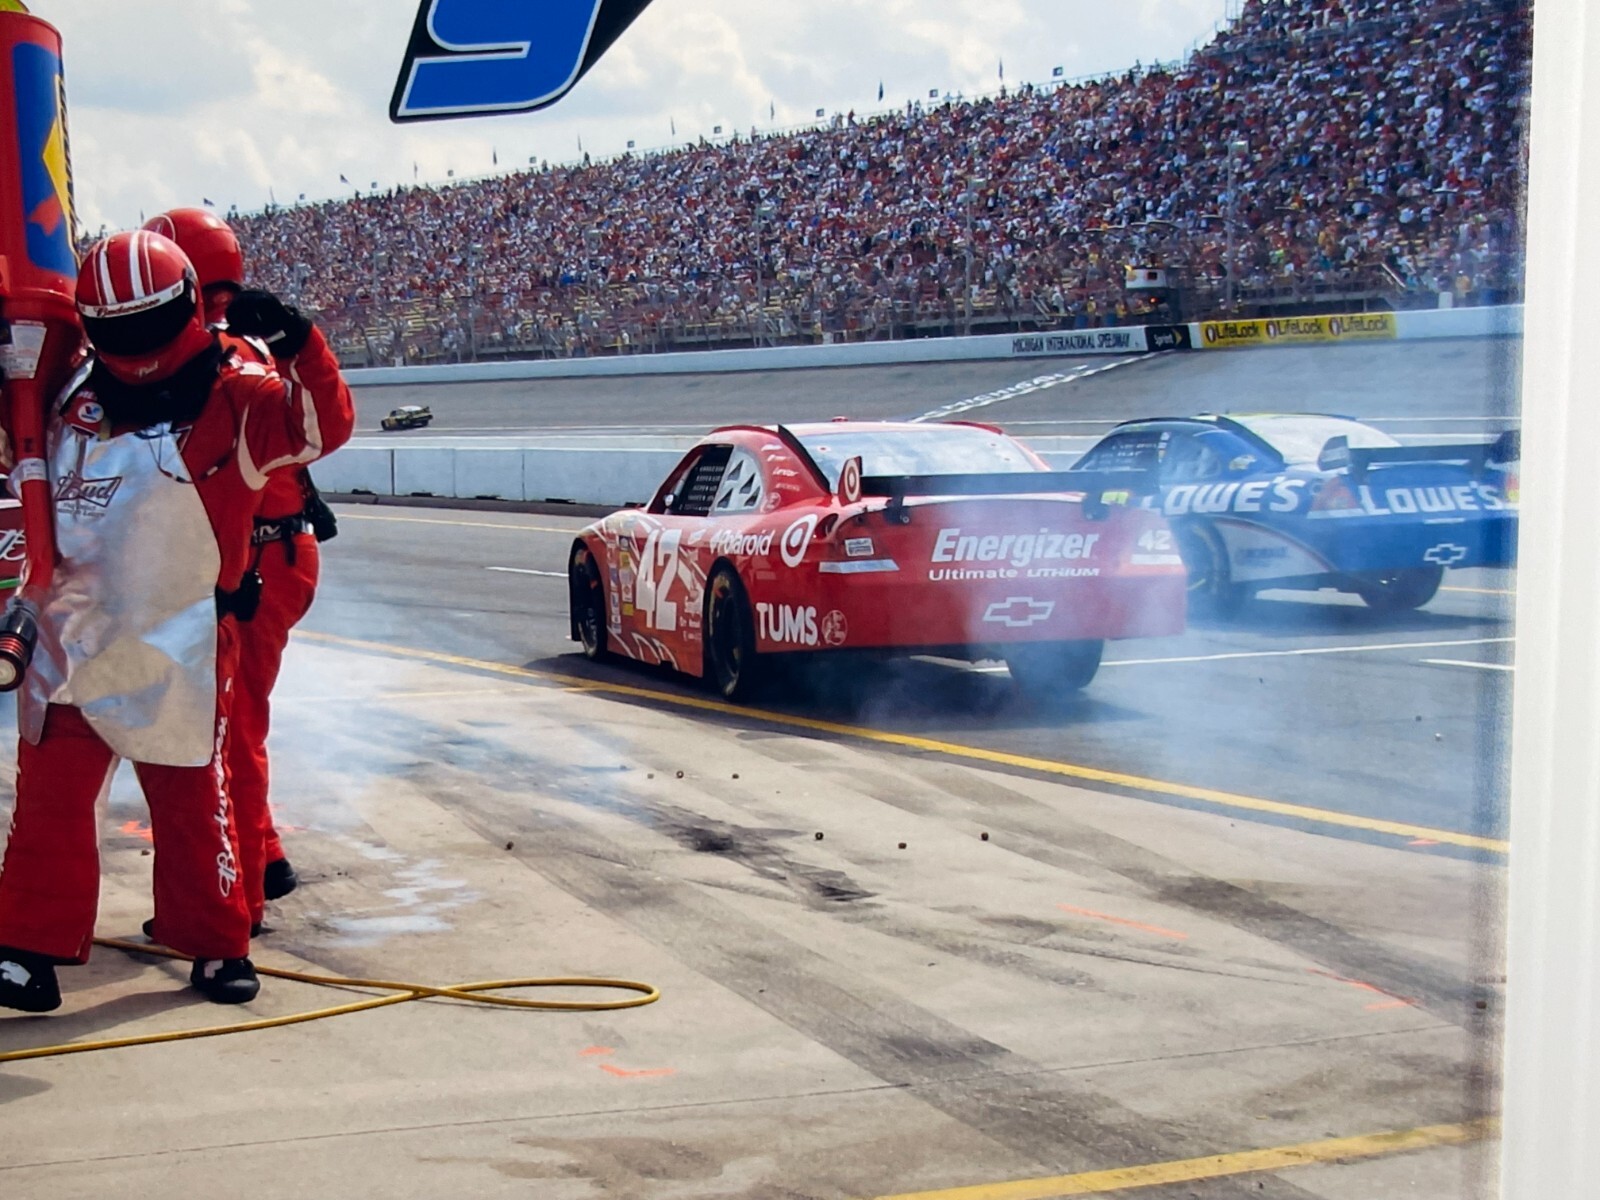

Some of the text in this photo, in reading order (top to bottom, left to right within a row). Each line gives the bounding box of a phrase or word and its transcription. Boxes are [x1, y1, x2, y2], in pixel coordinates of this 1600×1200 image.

[1216, 322, 1259, 339] LifeLock
[1277, 318, 1323, 336] LifeLock
[1340, 315, 1388, 333] LifeLock
[1012, 333, 1131, 353] MICHIGAN INTERNATIONAL SPEEDWAY
[1153, 333, 1174, 347] Sprint
[1358, 481, 1504, 515] LOWE'S
[718, 529, 776, 556] Polaroid
[931, 528, 1100, 567] Energizer
[1137, 530, 1171, 551] 42
[636, 529, 682, 631] 42
[928, 567, 1100, 581] Ultimate LITHIUM
[755, 602, 818, 646] TUMS
